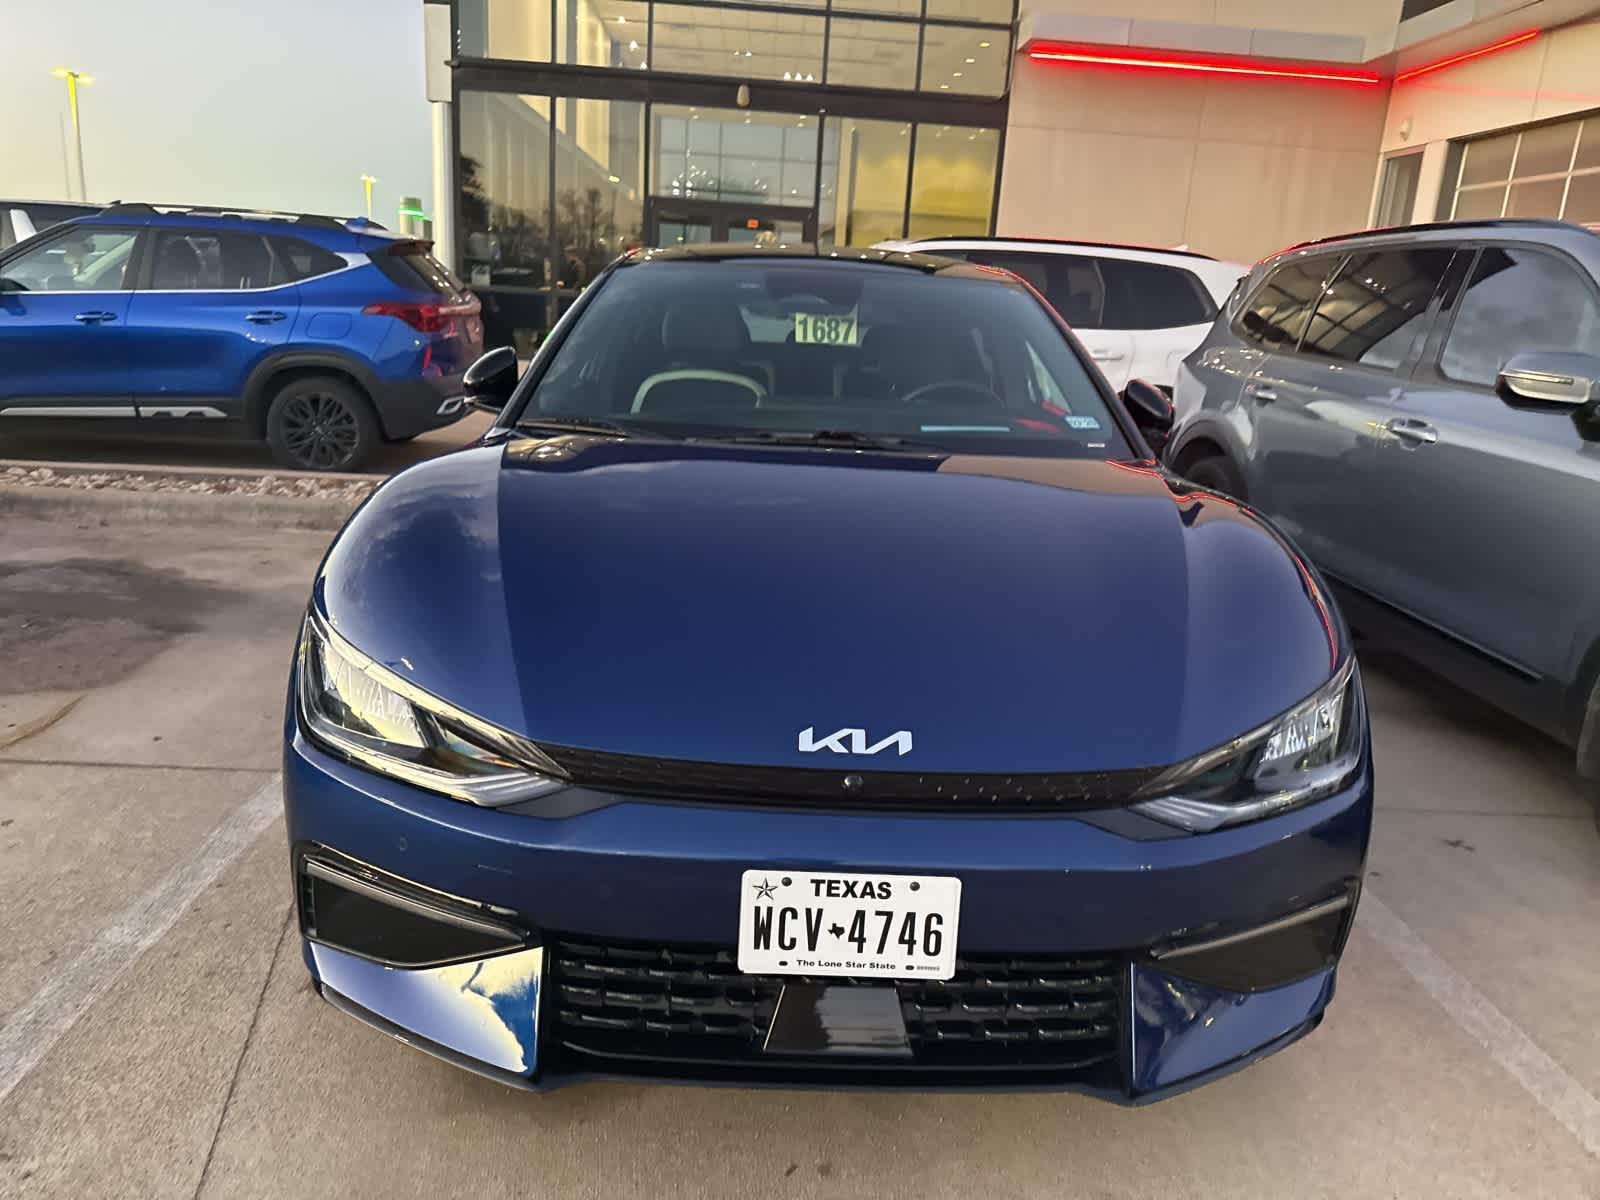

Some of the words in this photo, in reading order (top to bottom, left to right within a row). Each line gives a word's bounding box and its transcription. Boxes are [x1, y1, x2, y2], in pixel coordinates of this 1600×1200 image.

[798, 316, 855, 342] 1687
[798, 726, 913, 756] KIA
[810, 879, 892, 900] TEXAS
[753, 906, 824, 952] WCV
[848, 909, 944, 957] 4746
[796, 959, 815, 967] The
[818, 960, 842, 968] Lone
[845, 961, 867, 969] Star
[869, 962, 896, 970] State
